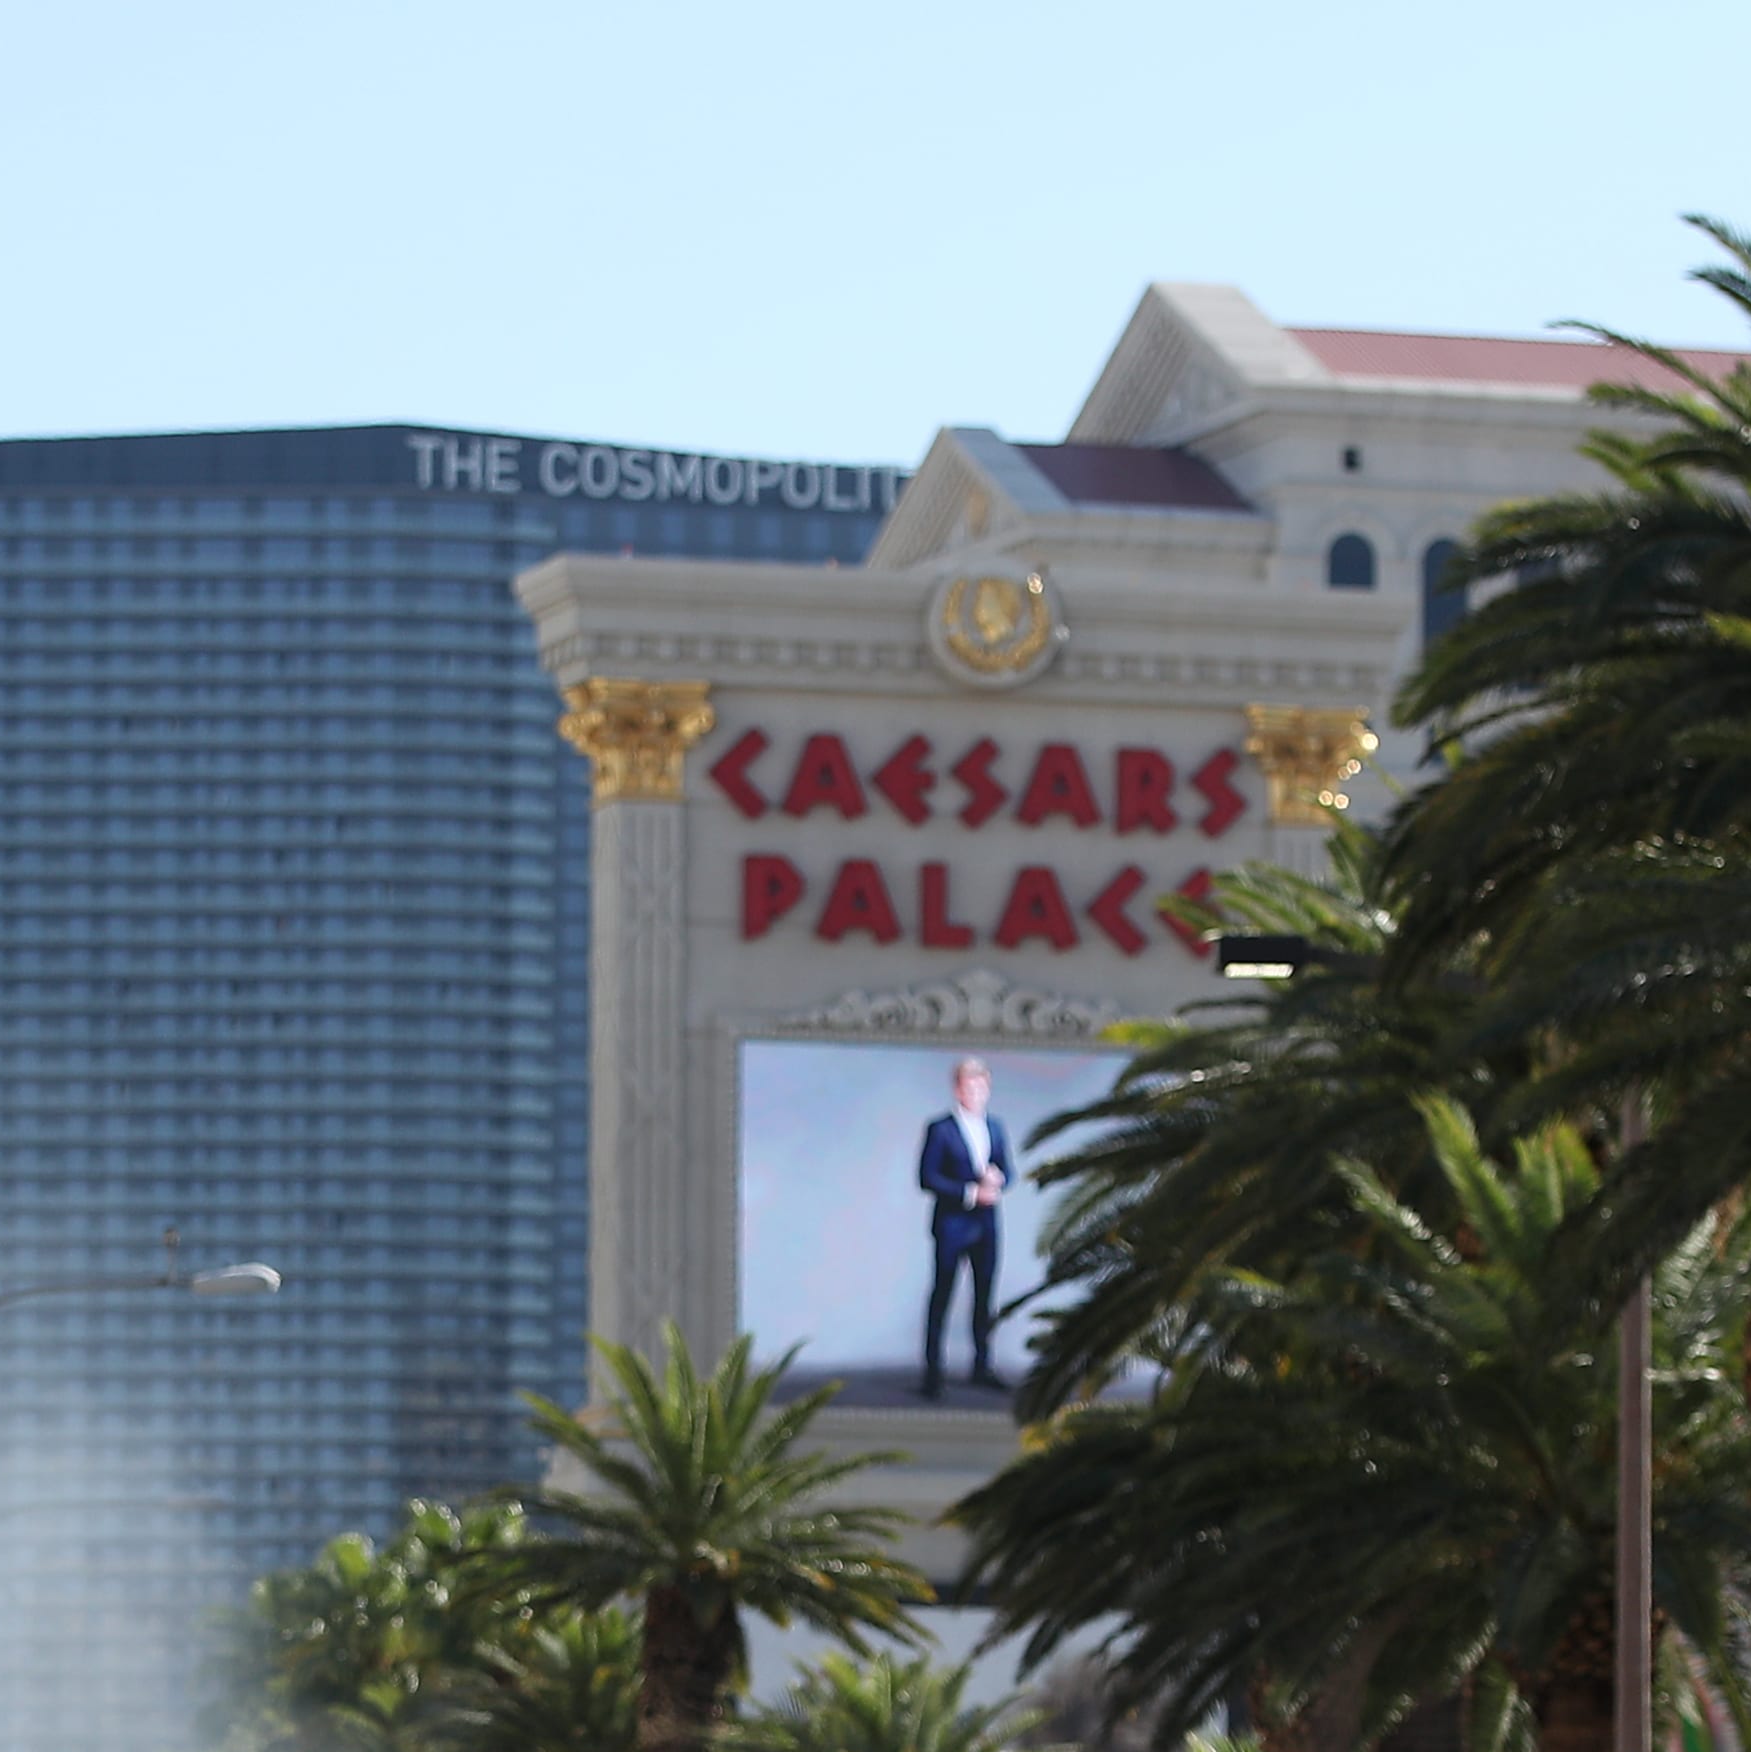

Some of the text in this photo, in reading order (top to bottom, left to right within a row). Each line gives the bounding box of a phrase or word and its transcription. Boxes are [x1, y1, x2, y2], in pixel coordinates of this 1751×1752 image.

[405, 432, 912, 512] THE COSMOPOLIT
[708, 727, 1247, 840] CAESARS
